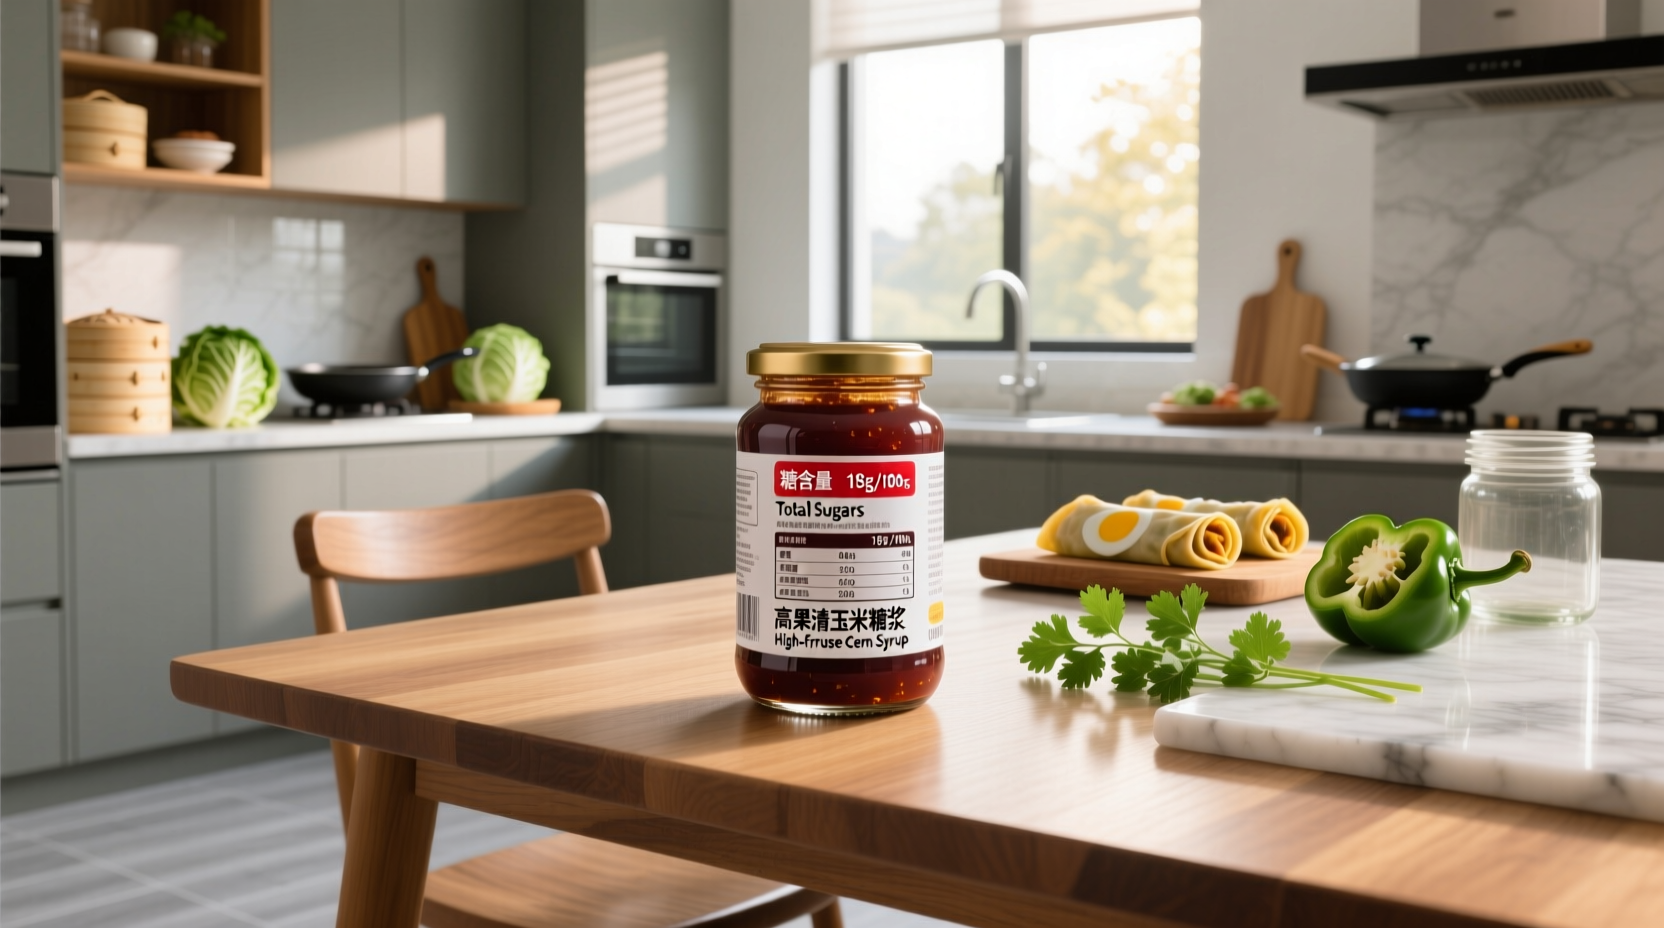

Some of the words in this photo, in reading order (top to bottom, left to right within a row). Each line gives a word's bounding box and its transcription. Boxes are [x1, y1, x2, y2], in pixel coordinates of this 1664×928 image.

[780, 469, 832, 491] 糖含量
[775, 500, 811, 517] Total
[815, 502, 864, 522] Sugars
[774, 606, 906, 633] 高果清玉米糖浆
[876, 634, 909, 651] Syrup
